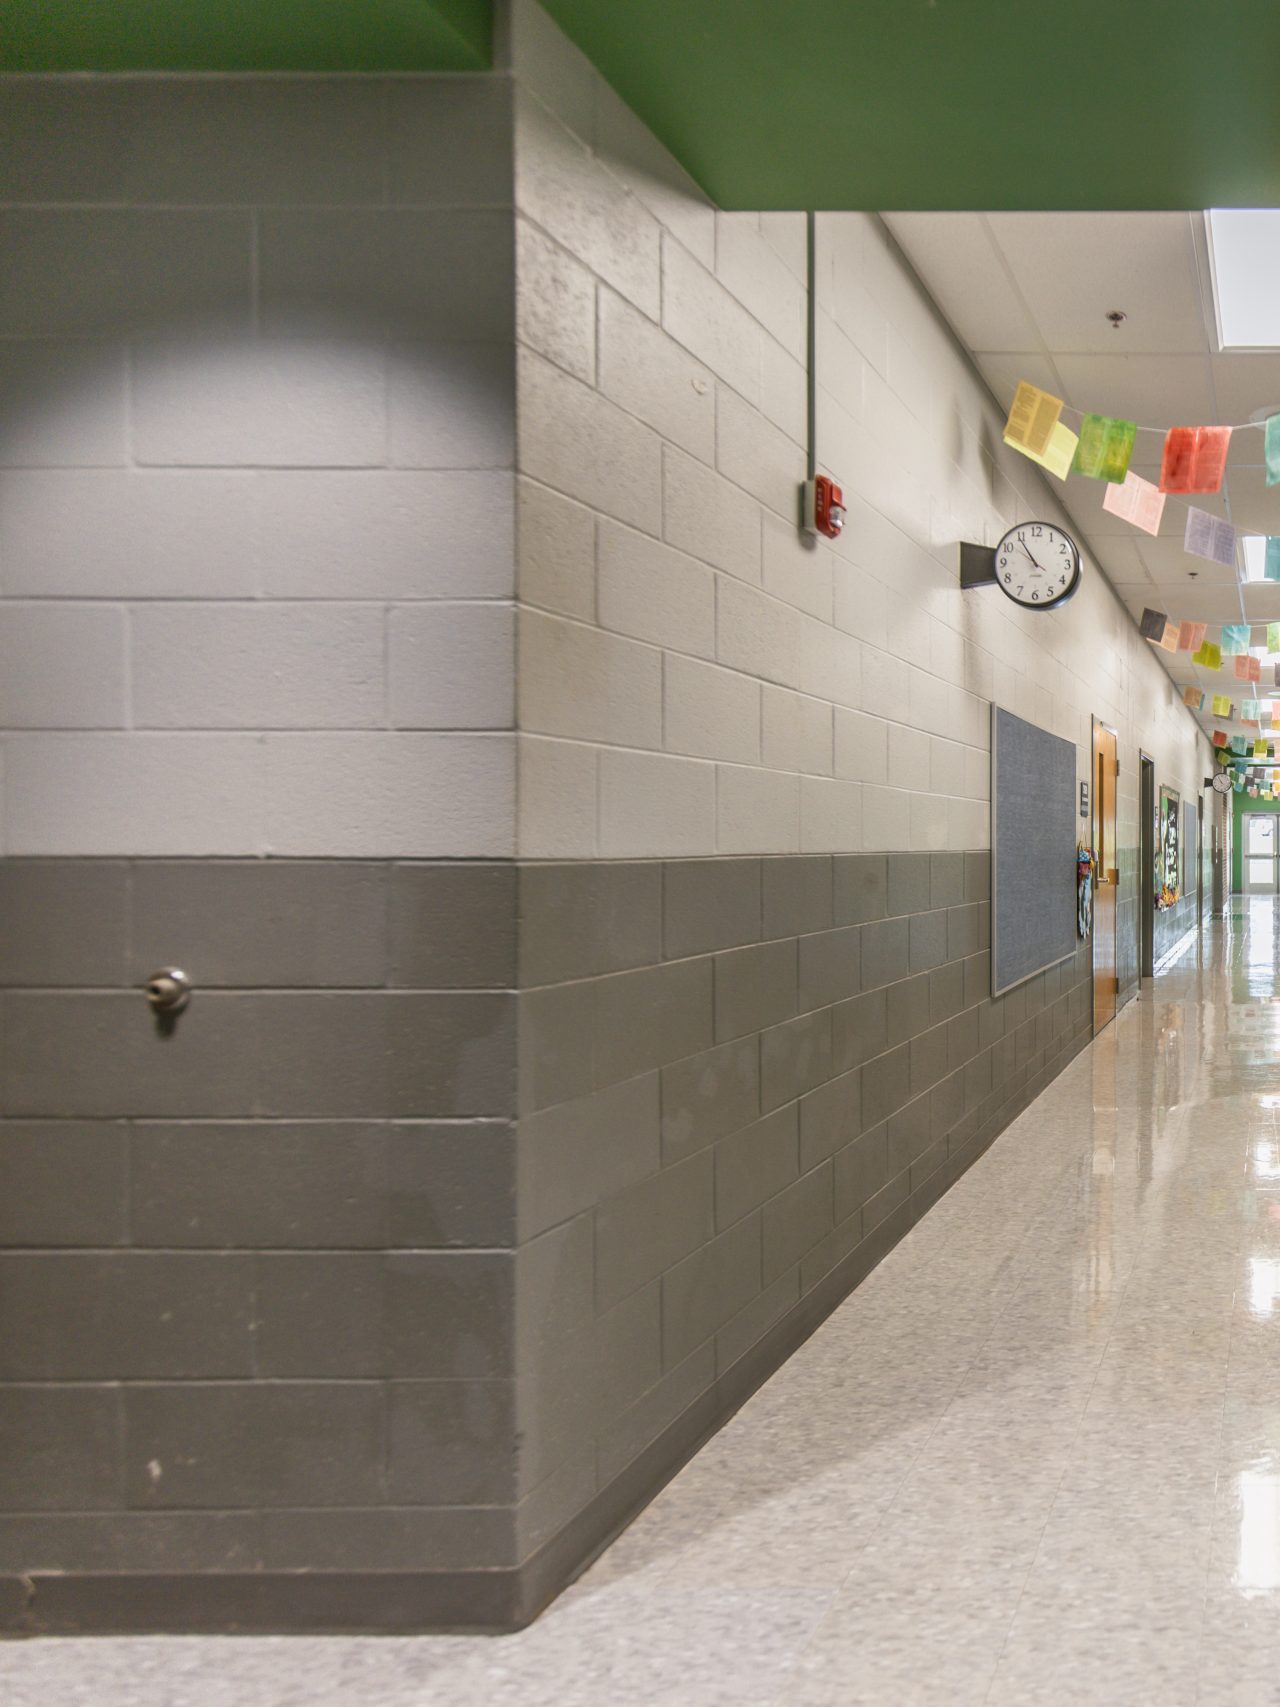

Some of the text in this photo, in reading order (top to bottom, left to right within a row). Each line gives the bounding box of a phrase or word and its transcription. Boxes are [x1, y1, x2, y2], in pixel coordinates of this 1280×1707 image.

[1031, 526, 1042, 537] 12
[1049, 532, 1053, 542] 1
[1003, 542, 1013, 552] 10
[1059, 543, 1066, 554] 2
[999, 558, 1007, 568] 9
[1064, 559, 1071, 570] 3
[1004, 573, 1011, 583] 8
[1059, 574, 1066, 584] 4
[1017, 586, 1024, 596] 7
[1031, 590, 1039, 600] 6
[1046, 586, 1054, 597] 5
